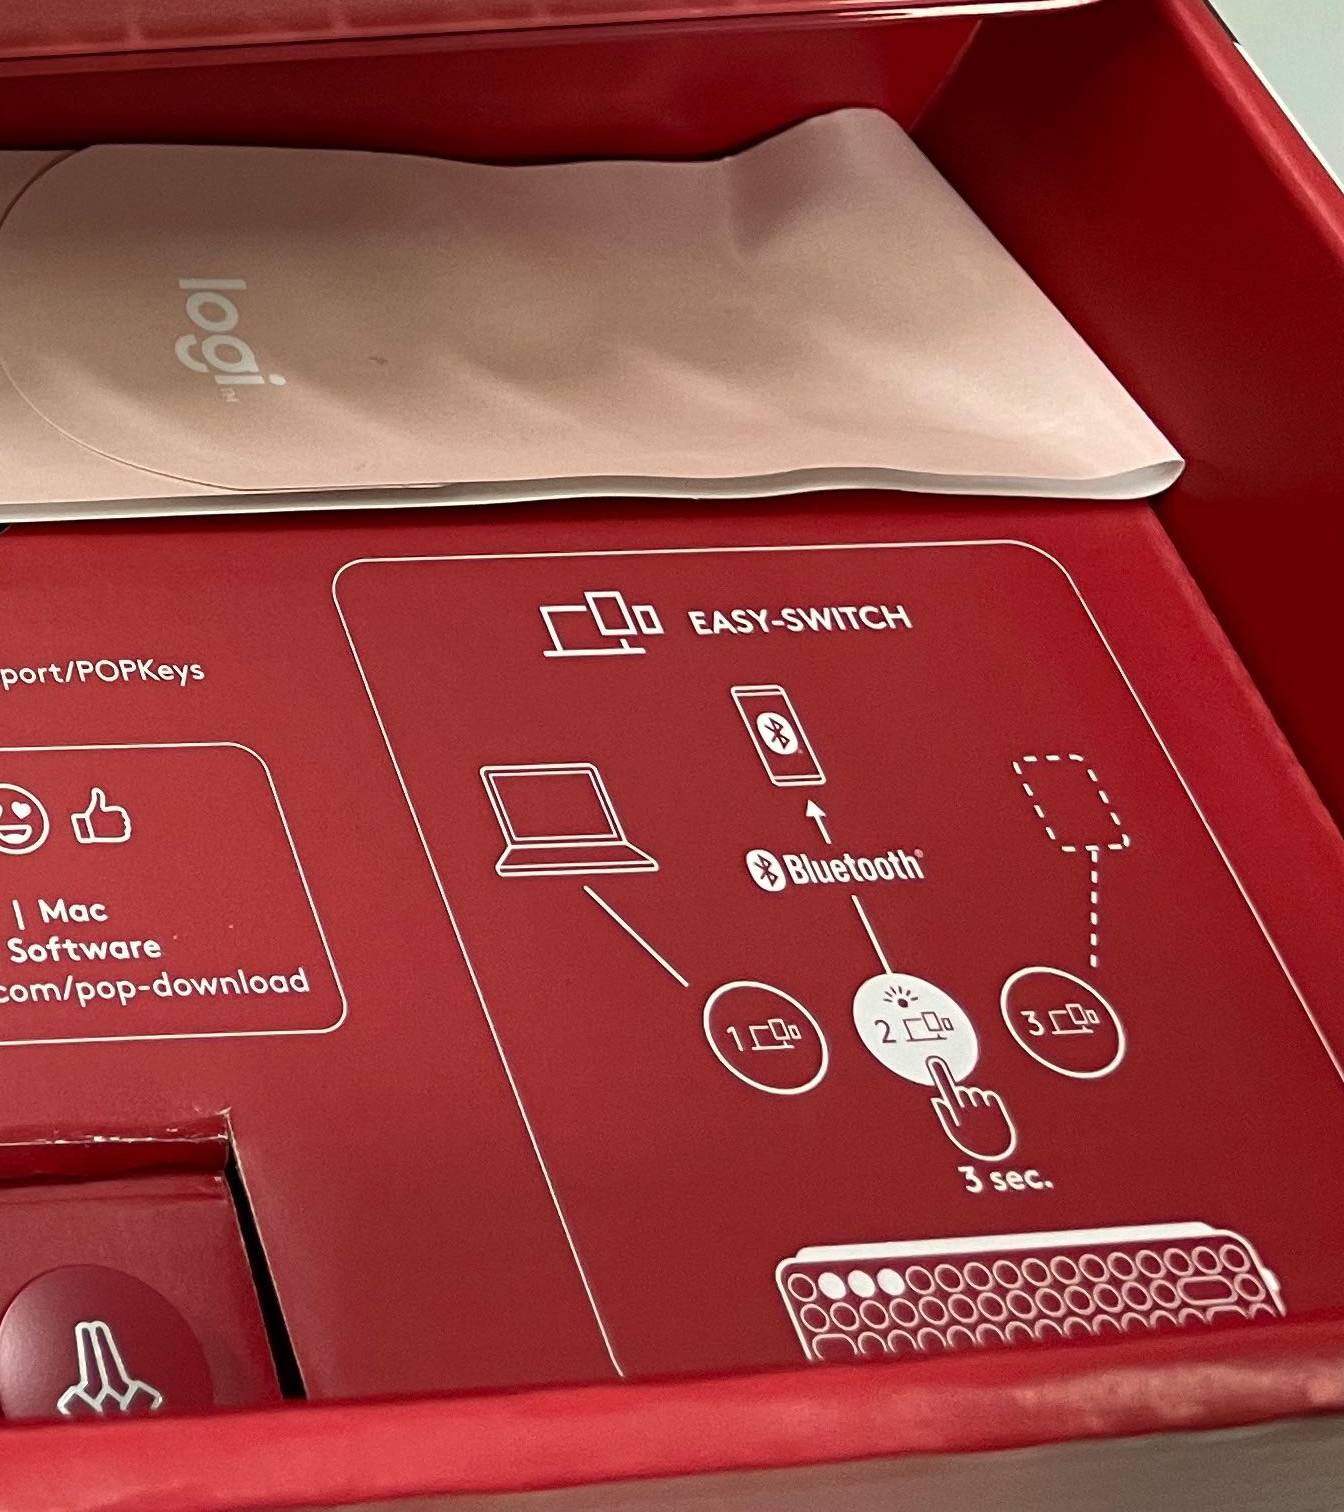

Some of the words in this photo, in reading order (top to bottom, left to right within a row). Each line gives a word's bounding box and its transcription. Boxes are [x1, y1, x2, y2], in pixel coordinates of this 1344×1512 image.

[175, 278, 287, 386] logi
[687, 605, 913, 635] EASY-SWITCH
[37, 898, 109, 923] Mac
[7, 935, 162, 963] Software
[874, 1019, 897, 1044] 2
[1020, 1010, 1045, 1036] 3
[726, 1025, 744, 1052] 1
[957, 1165, 984, 1194] 3
[989, 1169, 1054, 1192] sec.
